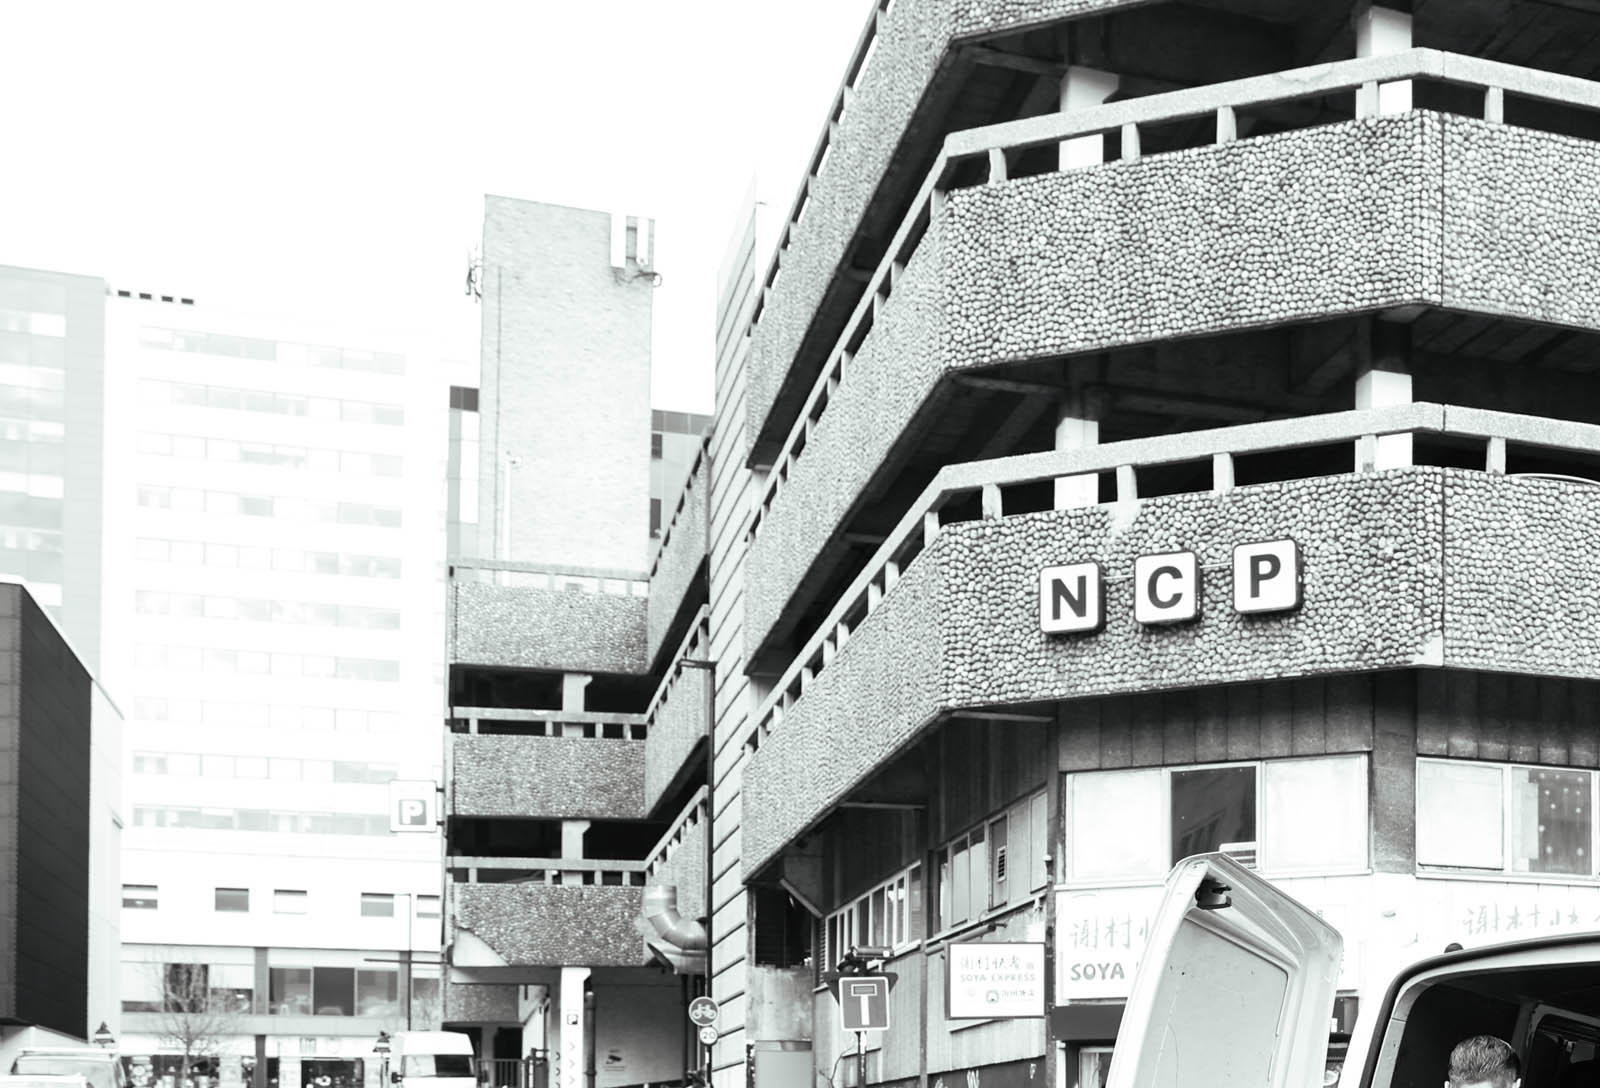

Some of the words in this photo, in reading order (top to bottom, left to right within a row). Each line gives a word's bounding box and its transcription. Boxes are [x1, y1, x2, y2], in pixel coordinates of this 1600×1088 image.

[1050, 553, 1282, 621] NCP
[401, 800, 424, 825] P
[960, 973, 987, 983] SOYA
[991, 972, 1036, 983] EXPRESS
[1069, 961, 1126, 982] SOYA
[702, 1030, 716, 1040] 20
